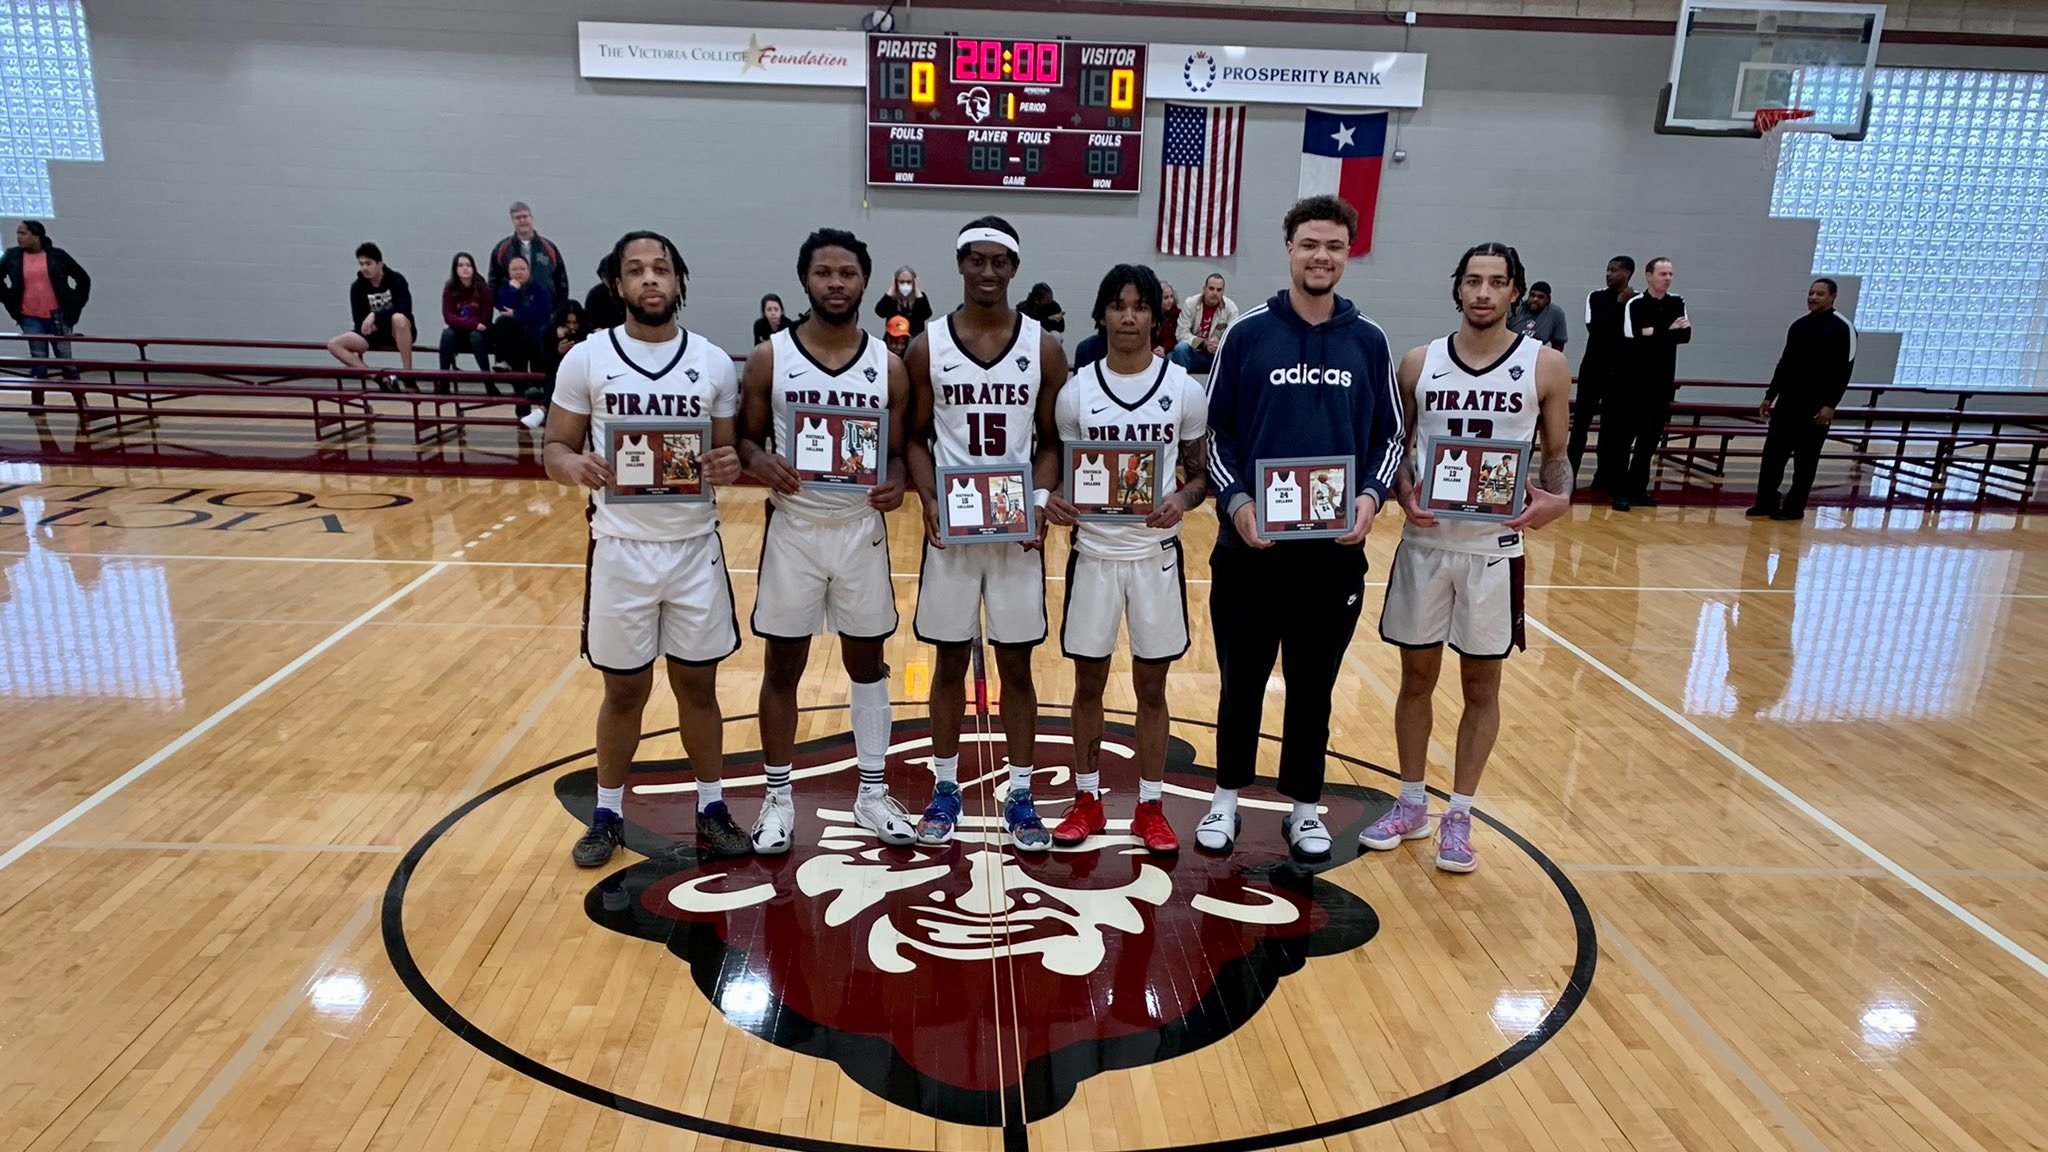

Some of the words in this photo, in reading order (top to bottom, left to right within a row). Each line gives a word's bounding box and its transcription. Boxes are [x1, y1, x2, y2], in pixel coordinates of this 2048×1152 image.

[598, 44, 623, 58] THE
[627, 45, 688, 61] VICTORIA
[691, 47, 748, 63] COLLEGE
[758, 47, 848, 66] Foundation
[876, 40, 937, 59] PIRATES
[1081, 47, 1136, 66] VISITOR
[956, 40, 1058, 82] 20:00
[911, 61, 935, 102] 0
[1222, 66, 1329, 84] PROSPERITY
[1333, 71, 1381, 85] BANK
[1110, 69, 1134, 110] 0
[1019, 101, 1046, 113] PERIOD
[890, 127, 924, 140] FOULS
[968, 130, 1008, 143] PLAYER
[1017, 131, 1051, 144] FOULS
[1088, 134, 1122, 147] FOULS
[895, 172, 914, 182] WON
[1002, 175, 1026, 186] GAME
[1092, 178, 1112, 189] WON
[785, 390, 880, 409] PIRATES
[942, 382, 1029, 406] PIRATES
[1425, 390, 1523, 413] PIRATES
[604, 392, 701, 418] PIRATES
[966, 412, 1007, 457] 15
[1088, 423, 1175, 444] PIRATES
